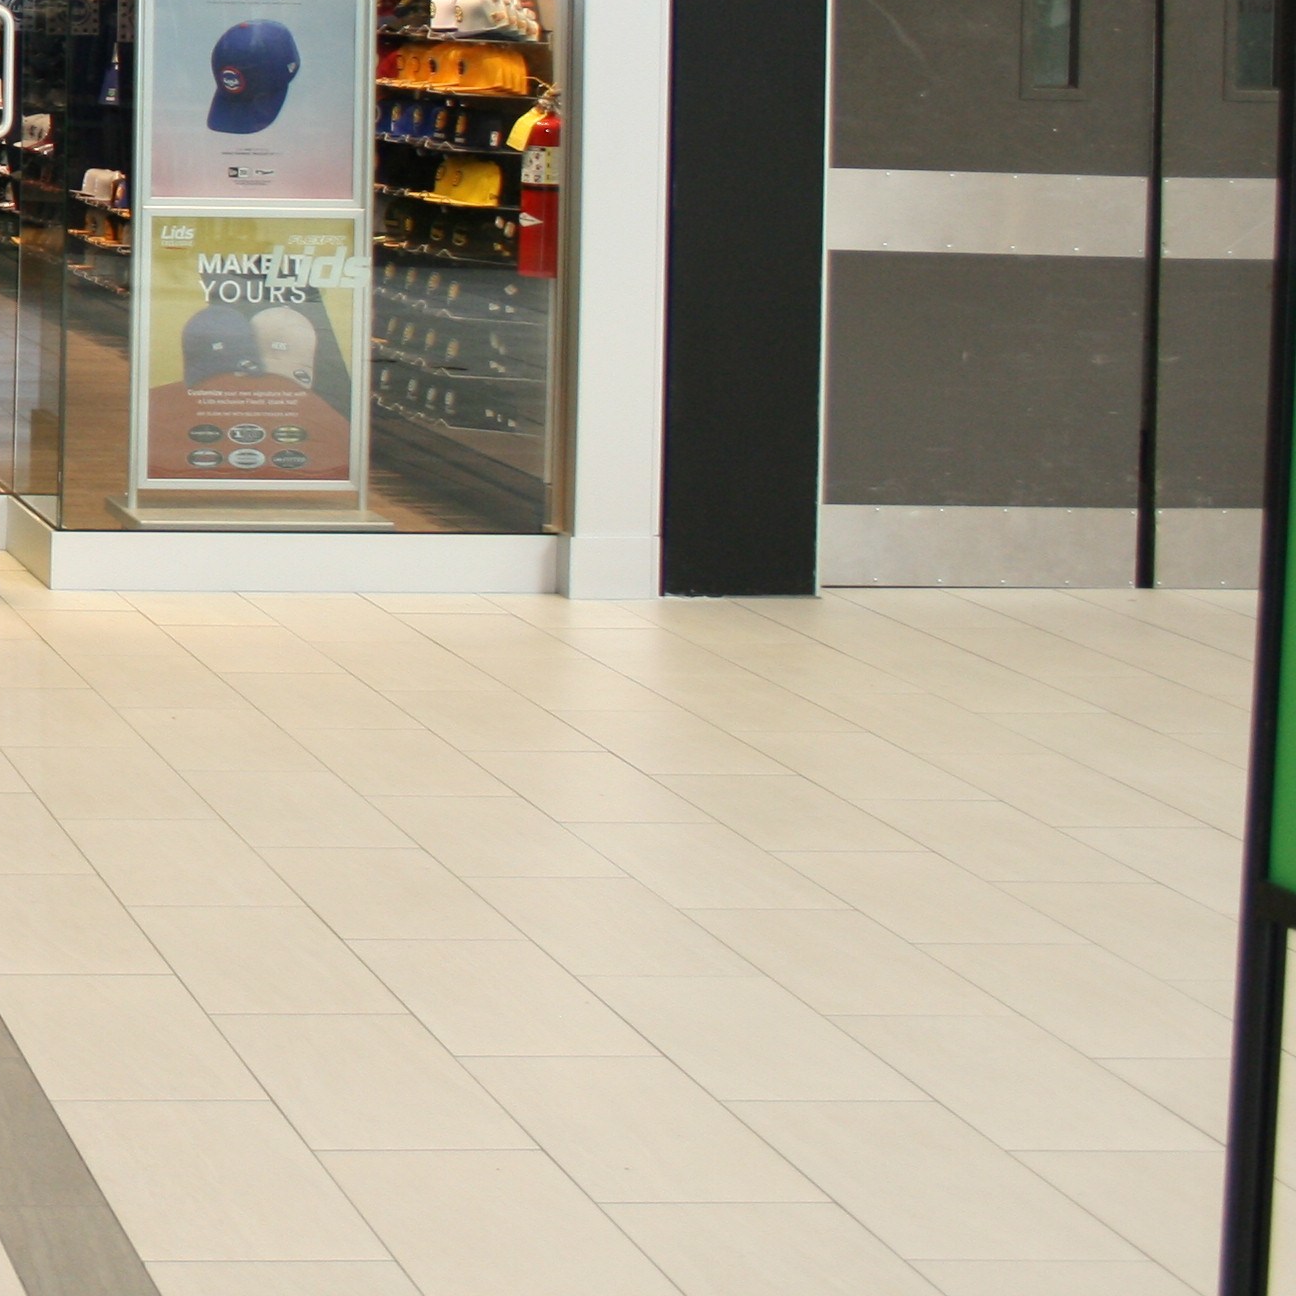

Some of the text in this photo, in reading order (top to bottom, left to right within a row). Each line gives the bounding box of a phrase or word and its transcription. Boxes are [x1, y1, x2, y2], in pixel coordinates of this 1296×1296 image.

[161, 226, 195, 240] Lids
[265, 245, 372, 288] Lids
[199, 280, 306, 304] YOURS
